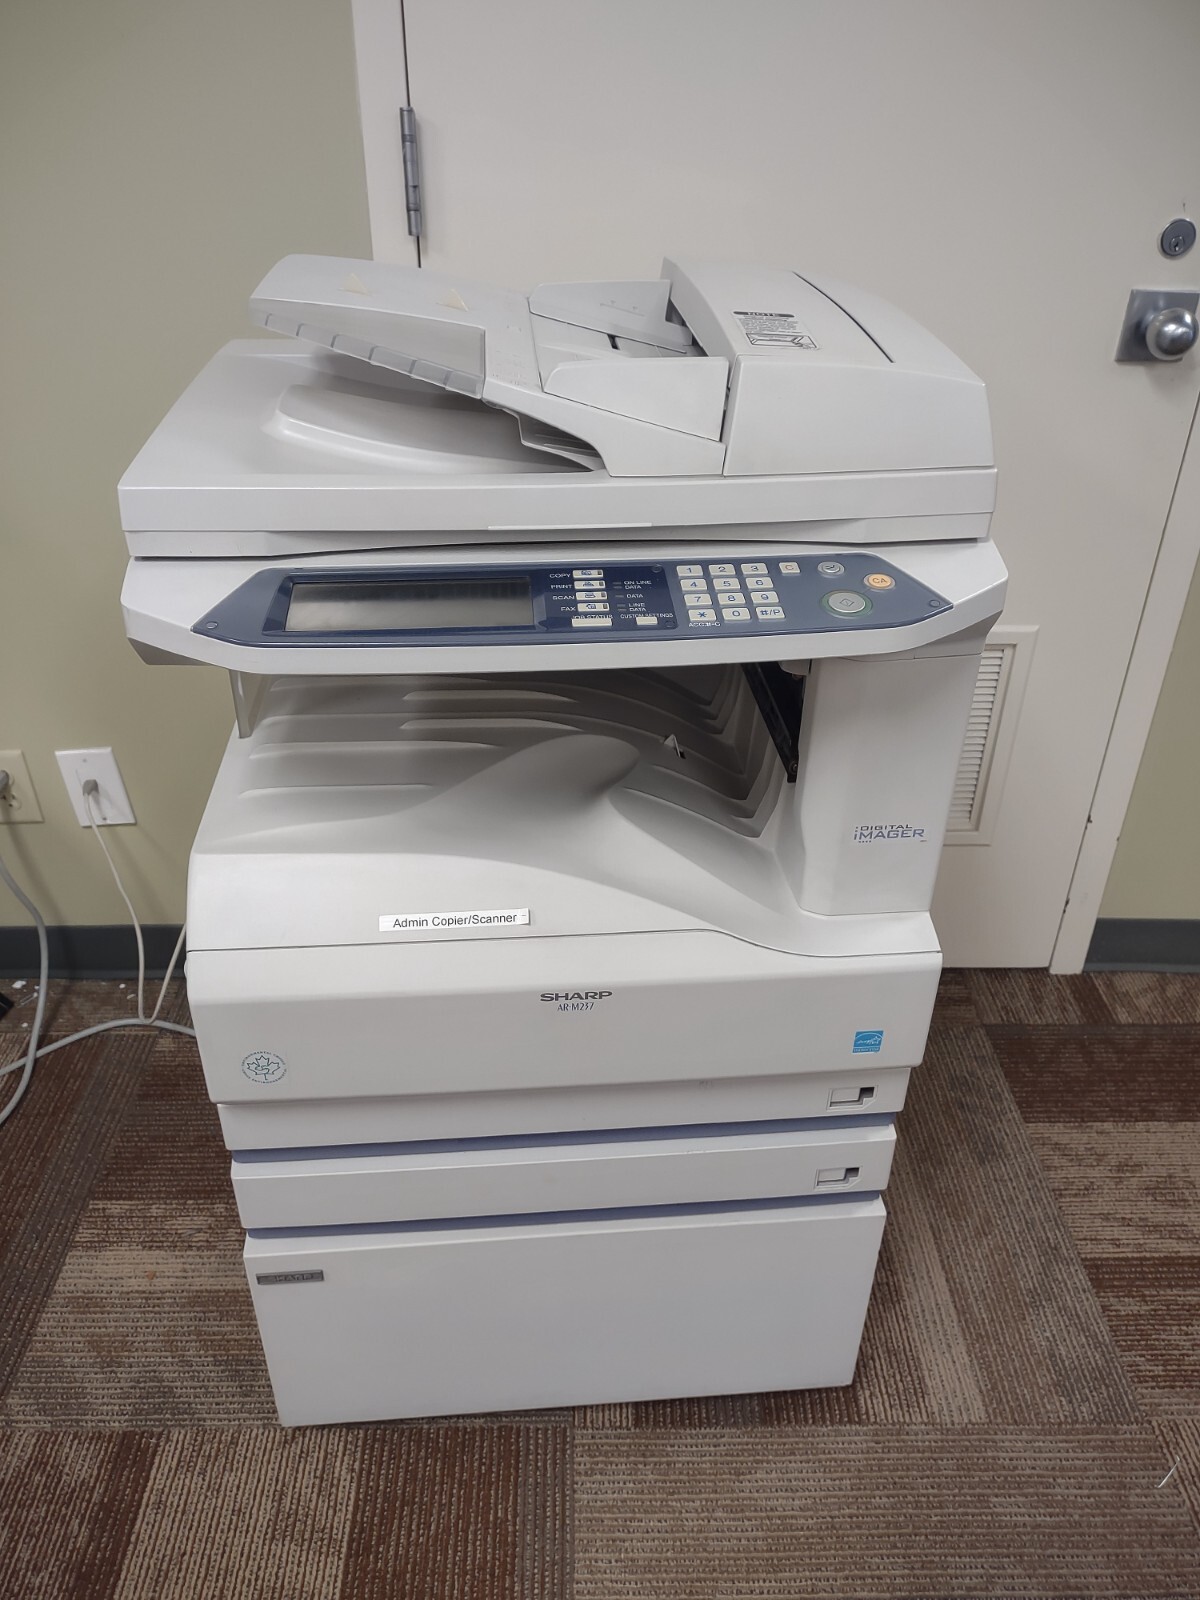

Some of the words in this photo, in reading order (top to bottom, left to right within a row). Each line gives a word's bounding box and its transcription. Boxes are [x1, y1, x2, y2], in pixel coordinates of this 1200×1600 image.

[759, 608, 780, 616] #/P
[393, 917, 429, 928] Admin
[432, 914, 518, 927] Copier/Scanner
[540, 990, 613, 1002] SHARP
[557, 1002, 595, 1012] AR-M237
